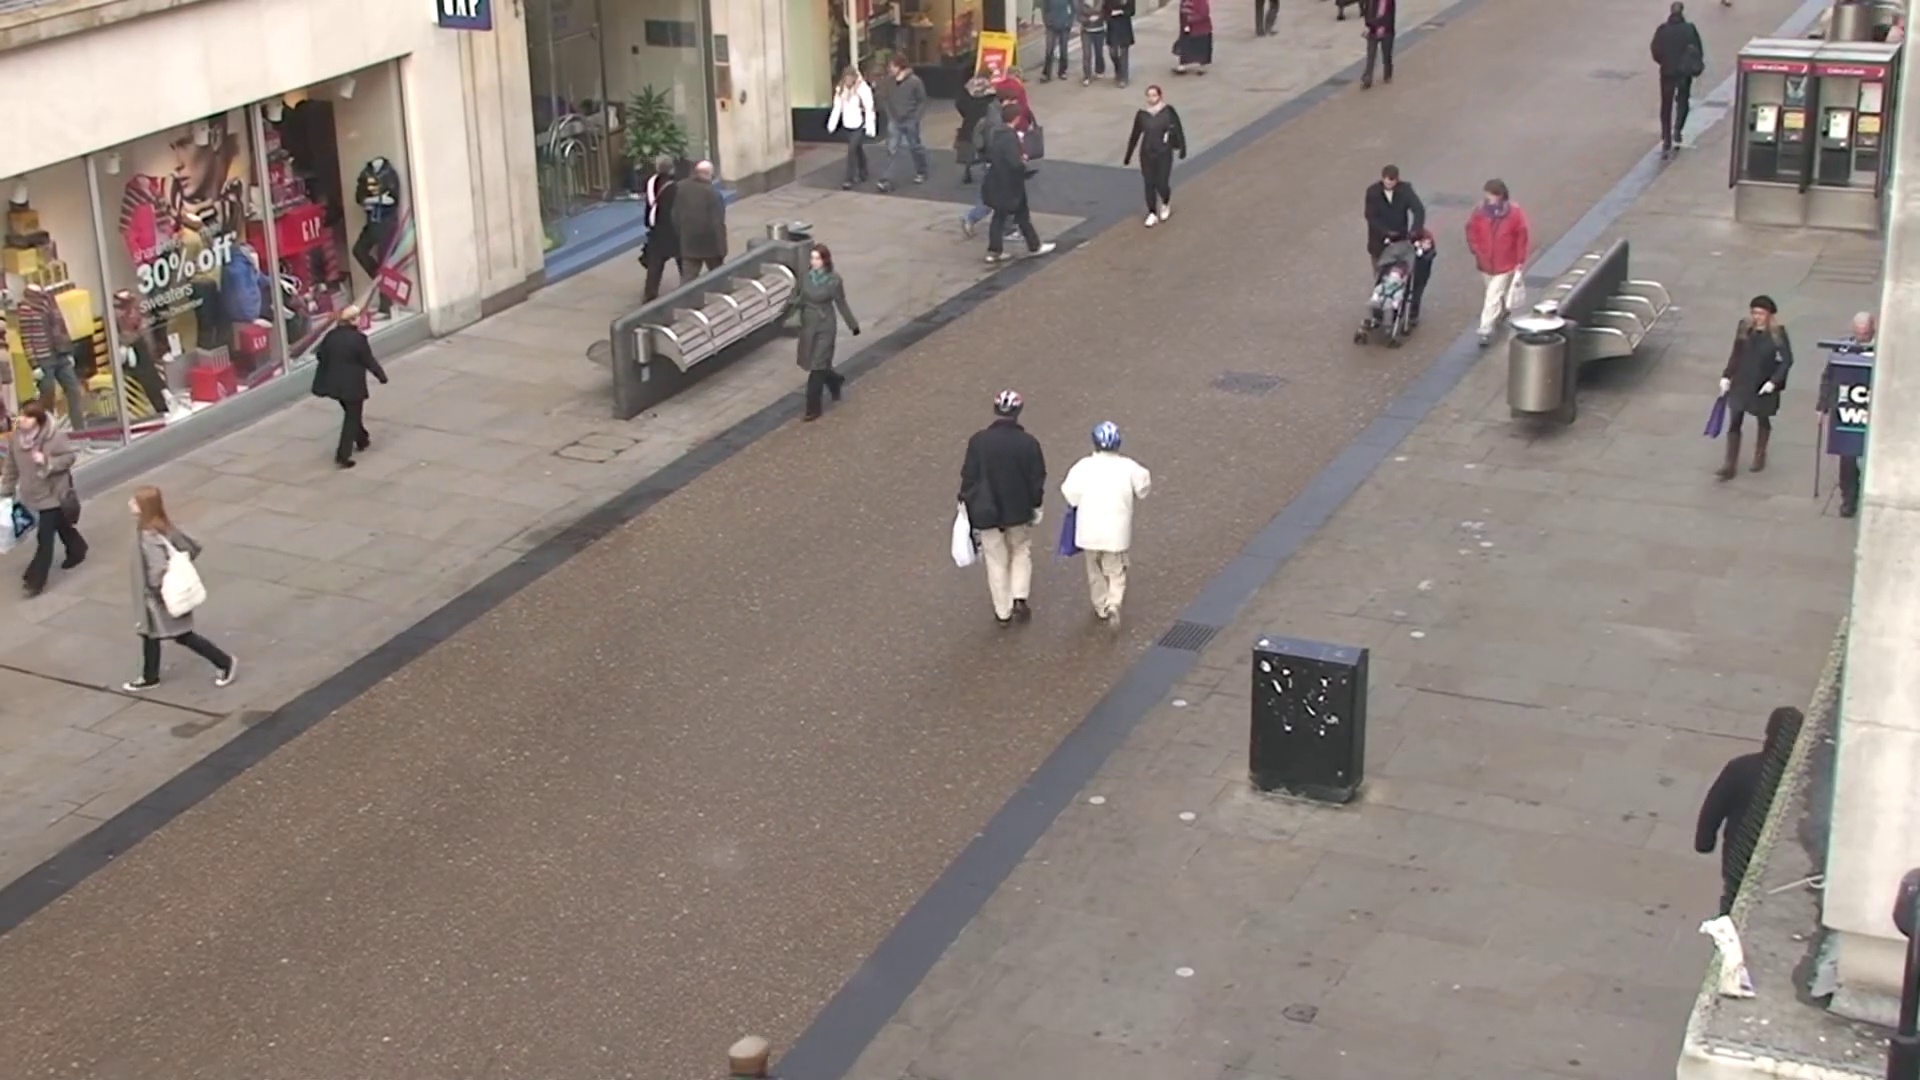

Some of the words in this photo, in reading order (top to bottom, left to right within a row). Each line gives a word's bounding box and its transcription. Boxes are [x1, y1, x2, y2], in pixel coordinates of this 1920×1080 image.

[301, 217, 322, 243] GAP
[137, 247, 195, 294] 30%
[139, 283, 194, 313] sweaters
